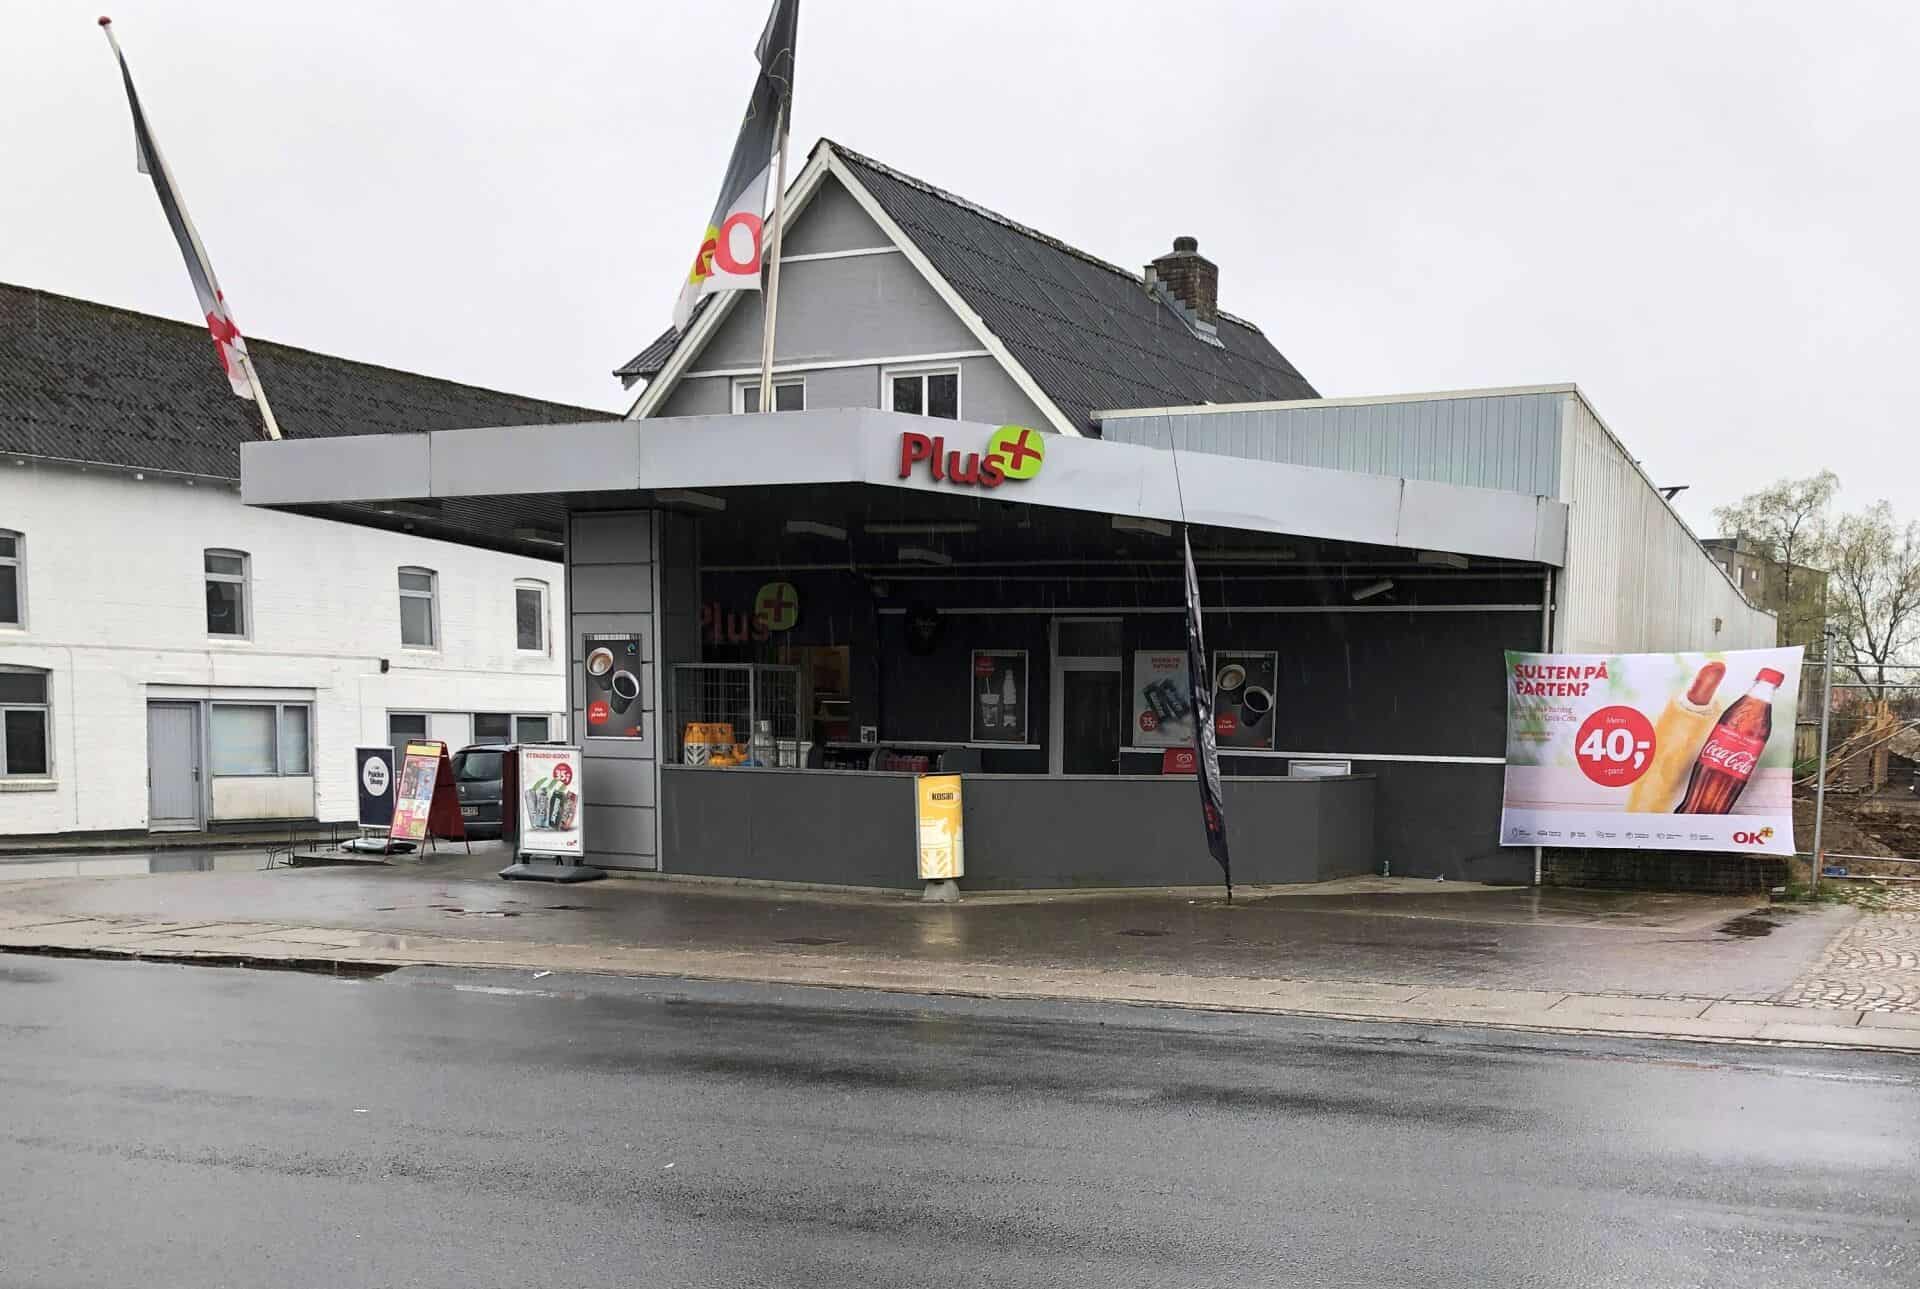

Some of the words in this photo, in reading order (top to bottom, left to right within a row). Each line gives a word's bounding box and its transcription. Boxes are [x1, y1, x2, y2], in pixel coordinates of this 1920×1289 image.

[899, 432, 1005, 488] Plus
[1514, 664, 1581, 680] SULTEN
[1584, 661, 1609, 680] PÅ
[1515, 682, 1590, 697] FARTEN?
[1732, 831, 1764, 845] OK
